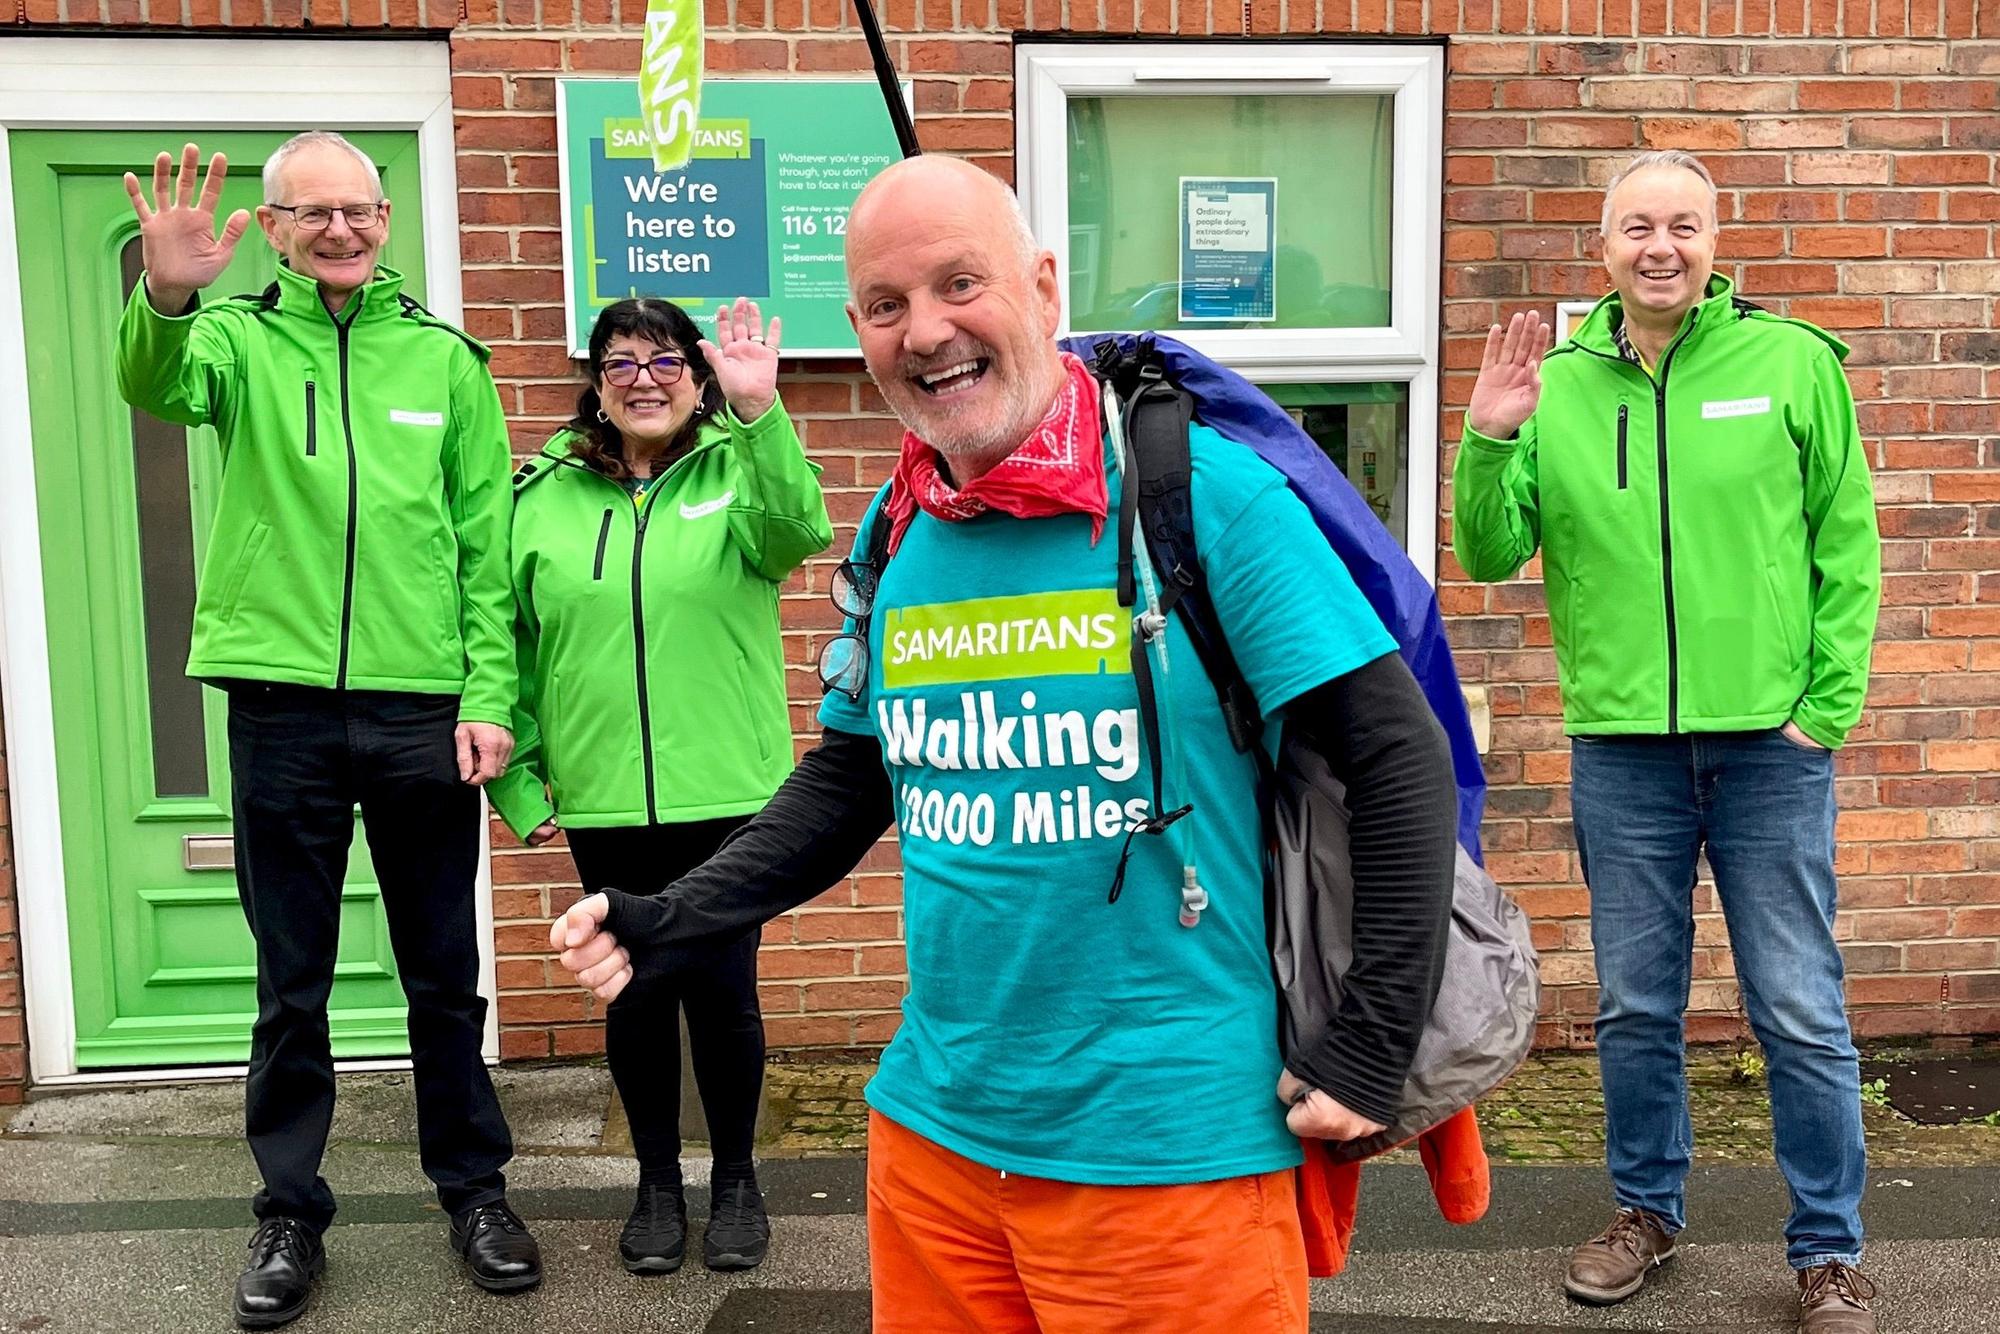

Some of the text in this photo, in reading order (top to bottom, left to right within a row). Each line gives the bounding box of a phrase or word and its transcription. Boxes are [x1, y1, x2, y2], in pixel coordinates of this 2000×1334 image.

[646, 0, 694, 145] ANS
[611, 128, 743, 147] SAMTANS
[778, 153, 890, 165] Whatever you're going
[779, 167, 868, 178] through, you don't
[624, 175, 718, 202] We're
[779, 180, 867, 190] have to face it alo
[1196, 207, 1232, 217] Ordinary
[626, 211, 736, 238] here to
[782, 215, 847, 235] 116 12
[1195, 219, 1247, 227] people doing
[1195, 229, 1250, 237] extraordinary
[1195, 238, 1220, 247] things
[628, 246, 711, 272] listen
[784, 253, 846, 264] jo@samaritan
[891, 613, 1116, 665] SAMARITANS
[877, 690, 1140, 782] Walking
[1012, 785, 1150, 844] Miles
